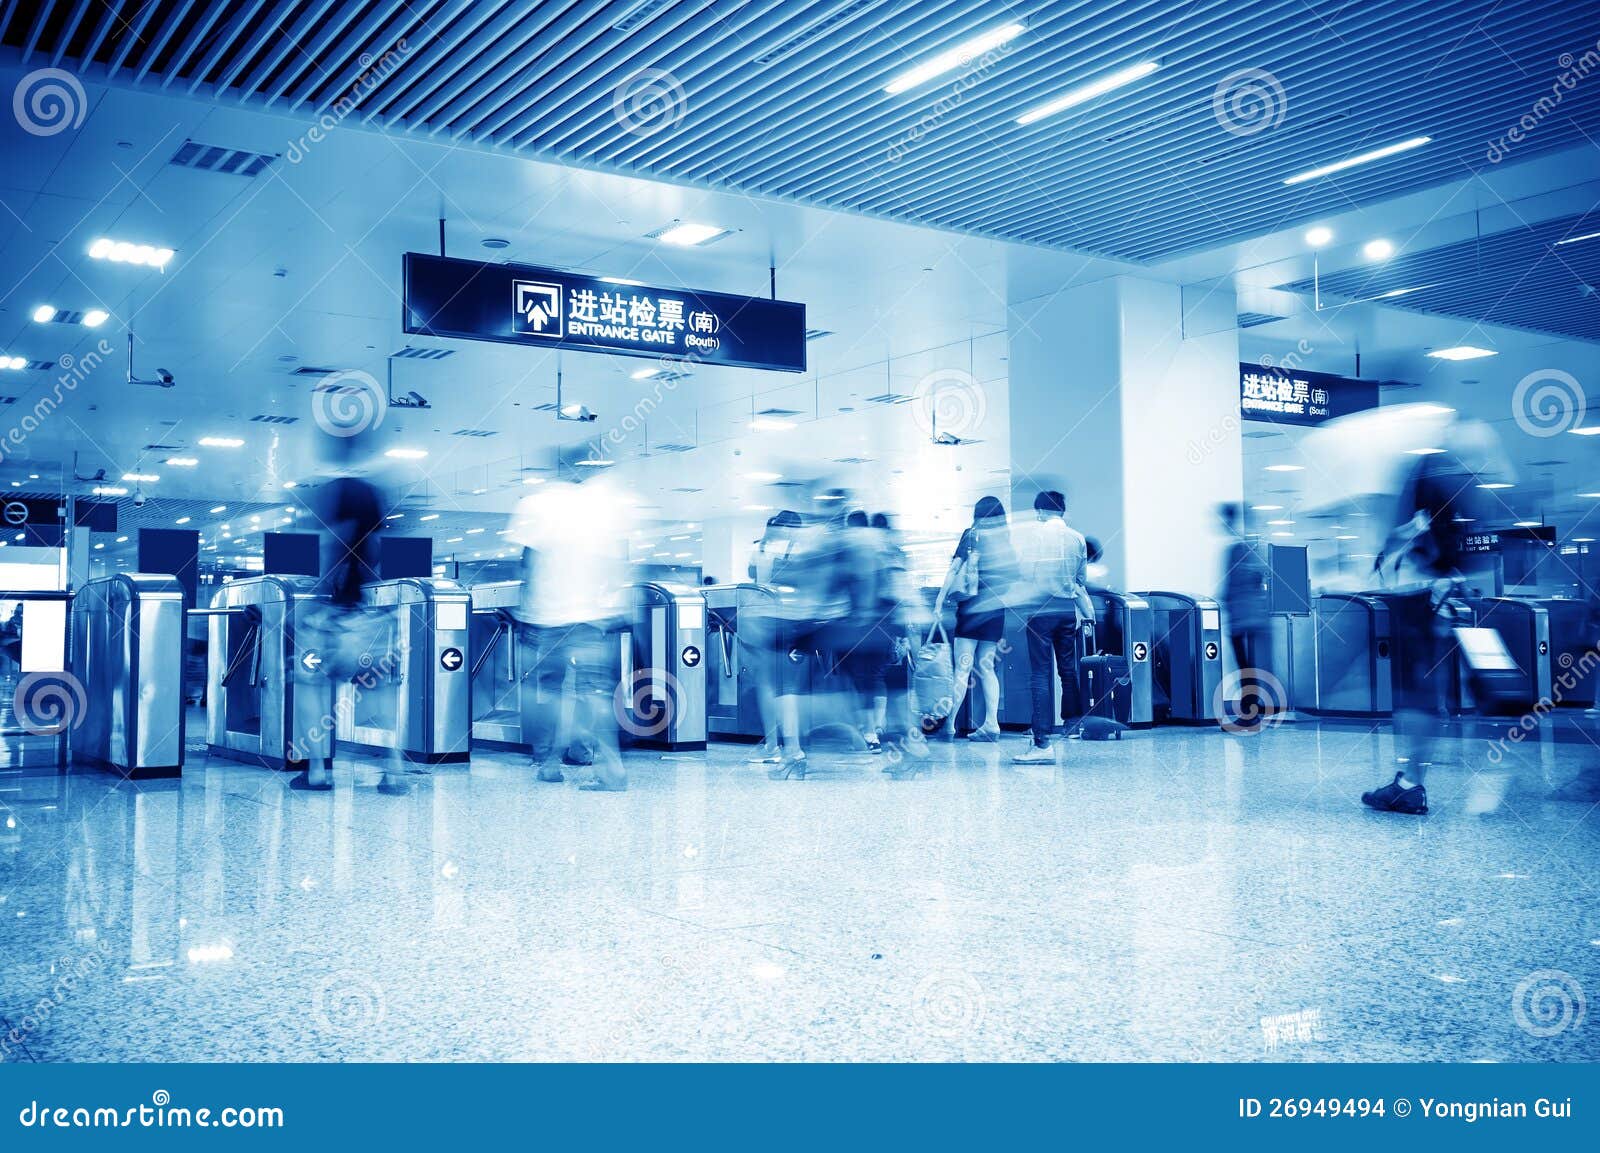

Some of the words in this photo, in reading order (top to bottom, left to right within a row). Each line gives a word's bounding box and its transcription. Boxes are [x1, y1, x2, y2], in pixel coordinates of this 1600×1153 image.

[568, 321, 639, 341] ENTRANCE
[641, 331, 676, 345] GATE
[684, 335, 720, 350] (South)
